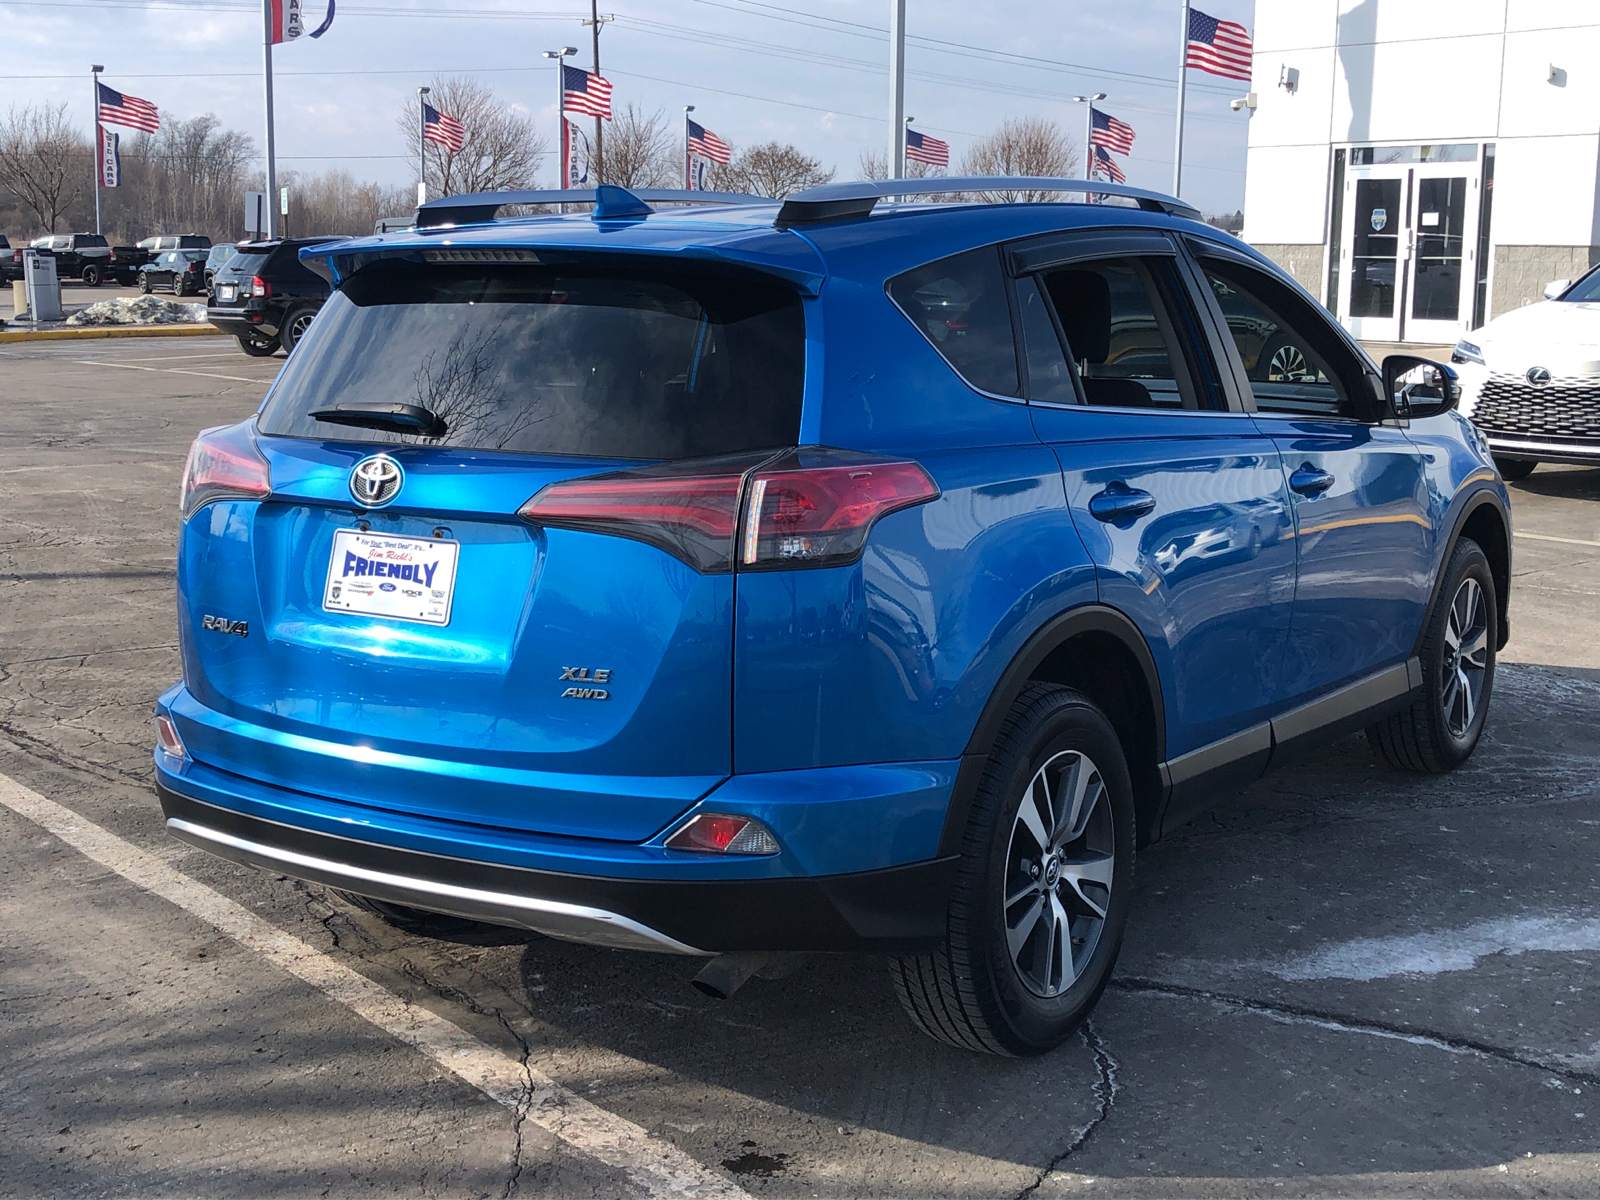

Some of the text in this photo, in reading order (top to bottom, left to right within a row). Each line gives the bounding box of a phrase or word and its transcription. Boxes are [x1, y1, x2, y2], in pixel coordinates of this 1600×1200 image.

[287, 0, 301, 38] ARS
[106, 158, 114, 185] CARS
[570, 156, 579, 187] CARS
[367, 548, 413, 561] Jim Riehl's
[369, 539, 382, 548] Your
[342, 549, 439, 588] FRIENDLY
[201, 614, 249, 638] RAV4
[558, 666, 611, 683] XLE
[560, 687, 608, 700] AWD
